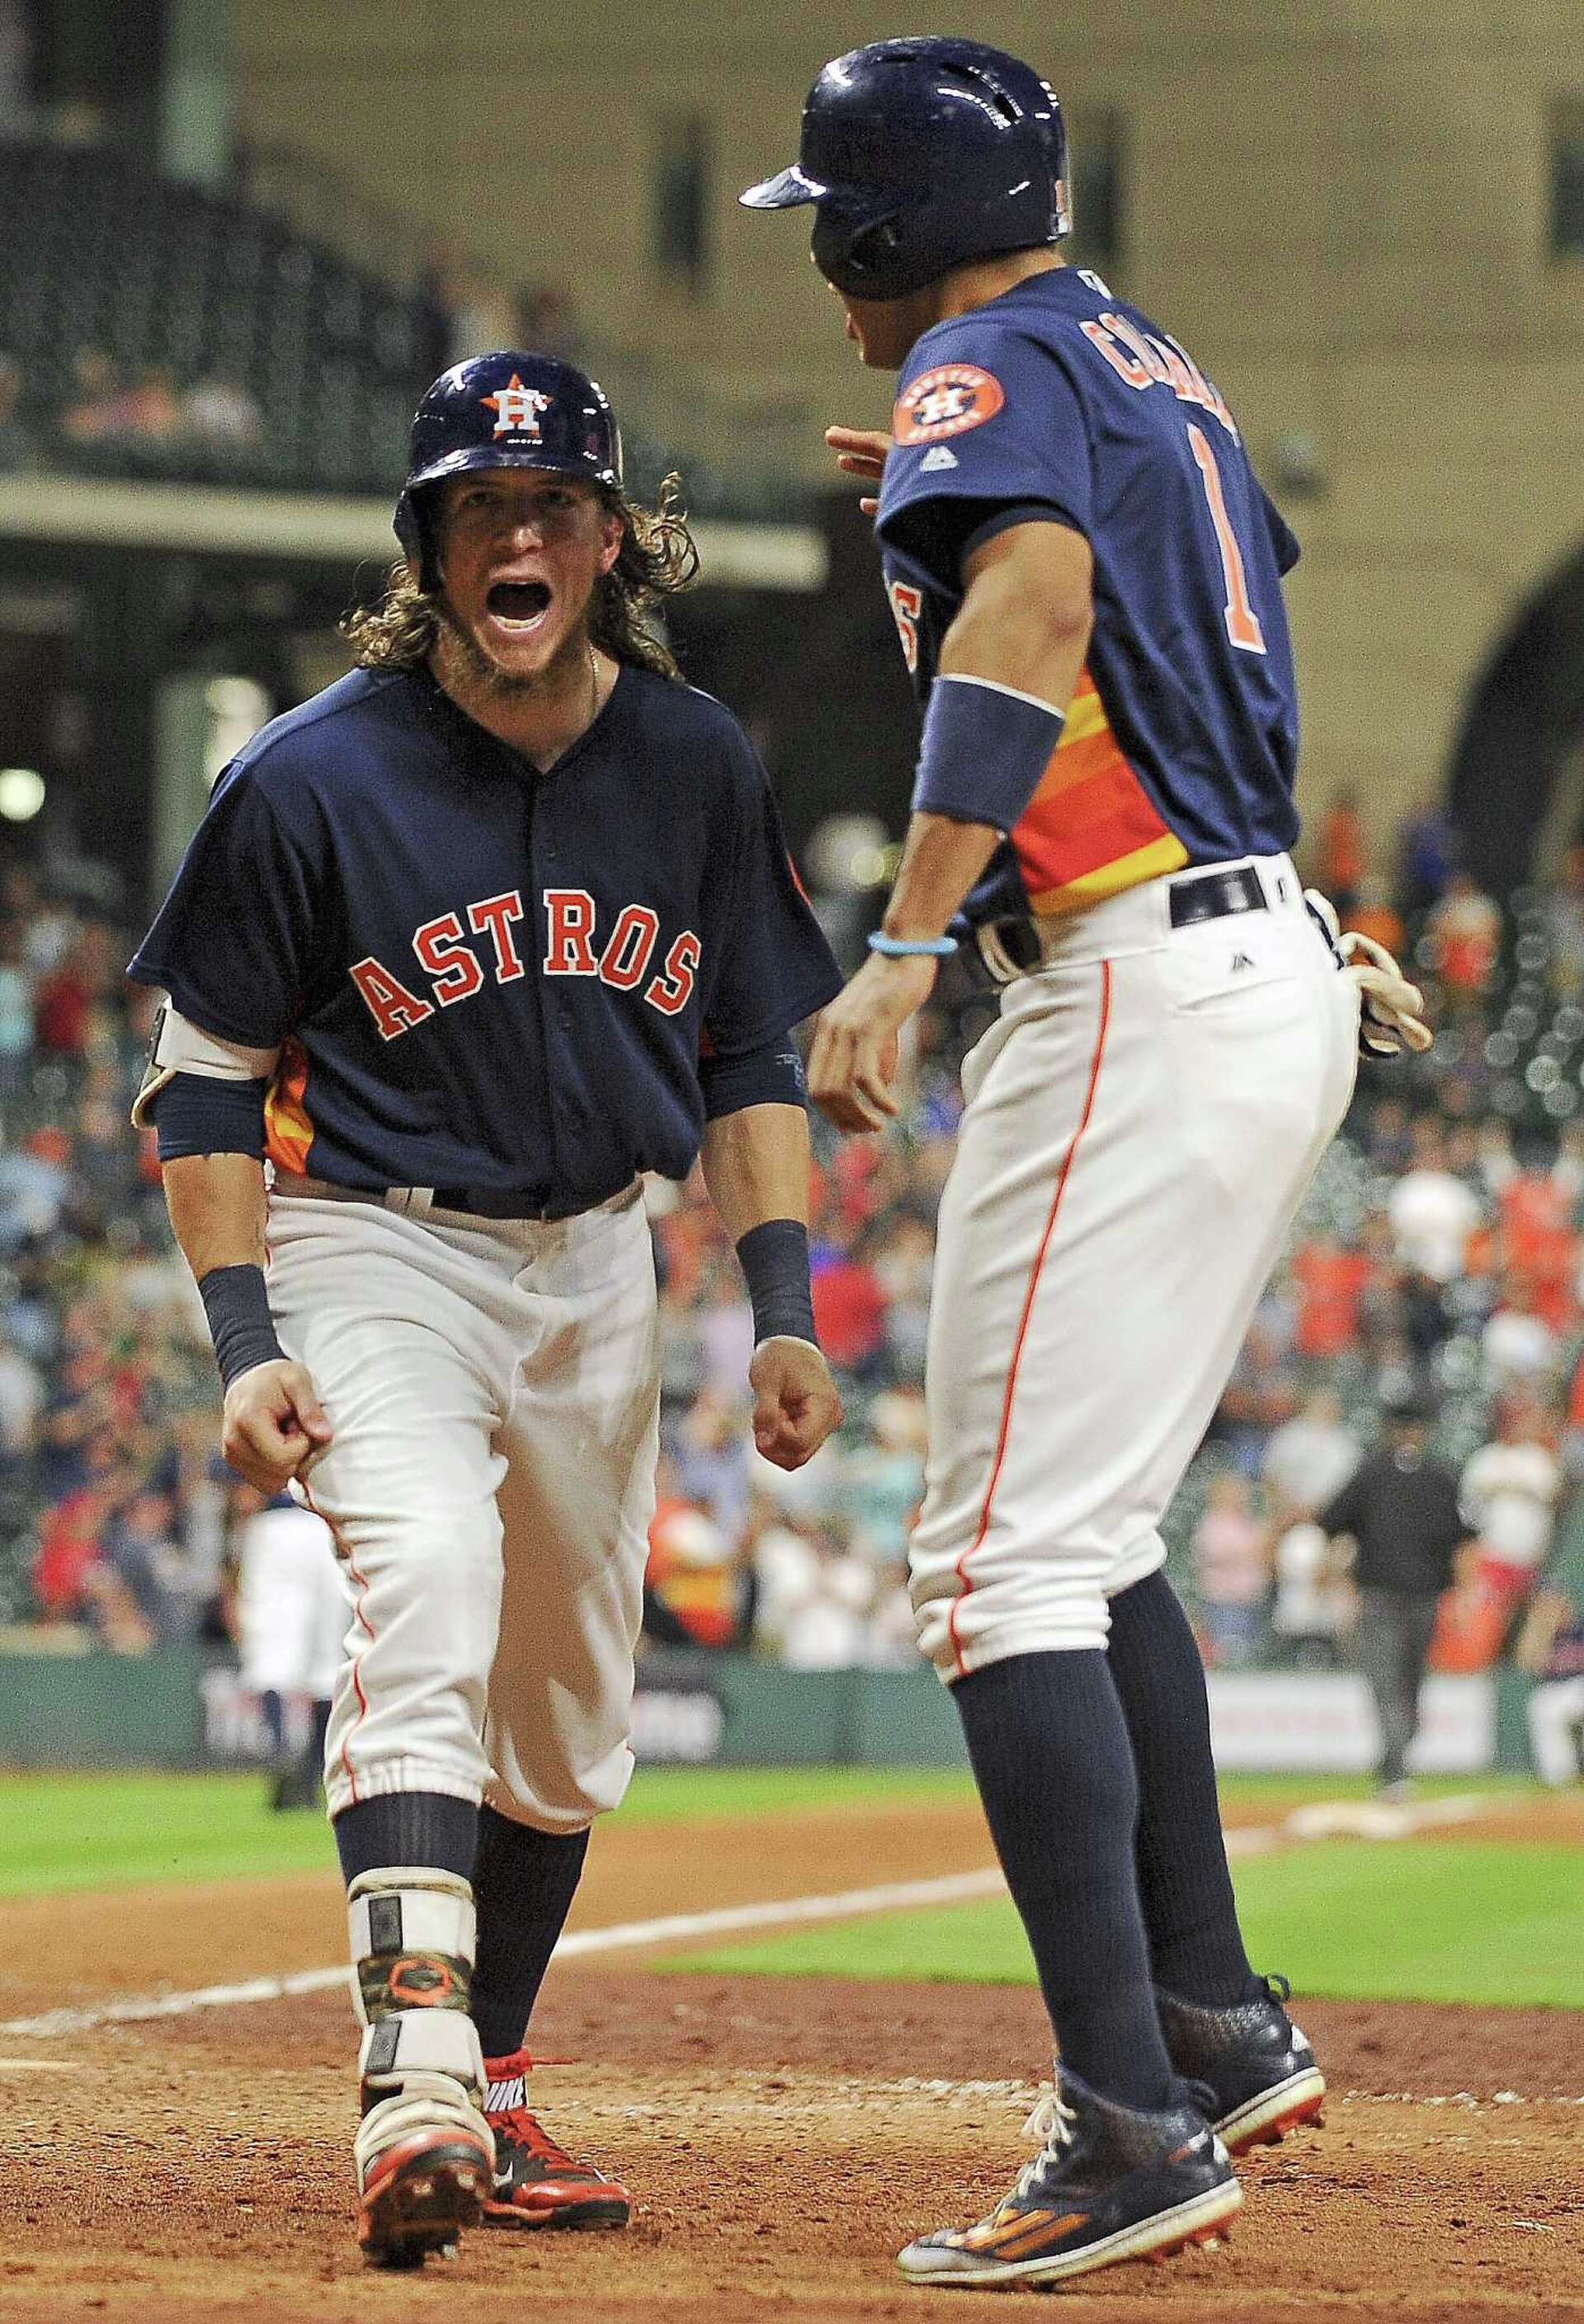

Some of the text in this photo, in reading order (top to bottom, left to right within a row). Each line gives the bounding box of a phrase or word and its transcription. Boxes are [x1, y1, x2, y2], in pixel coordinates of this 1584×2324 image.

[493, 388, 541, 431] H
[1186, 422, 1266, 655] 1
[349, 889, 702, 1041] ASTROS
